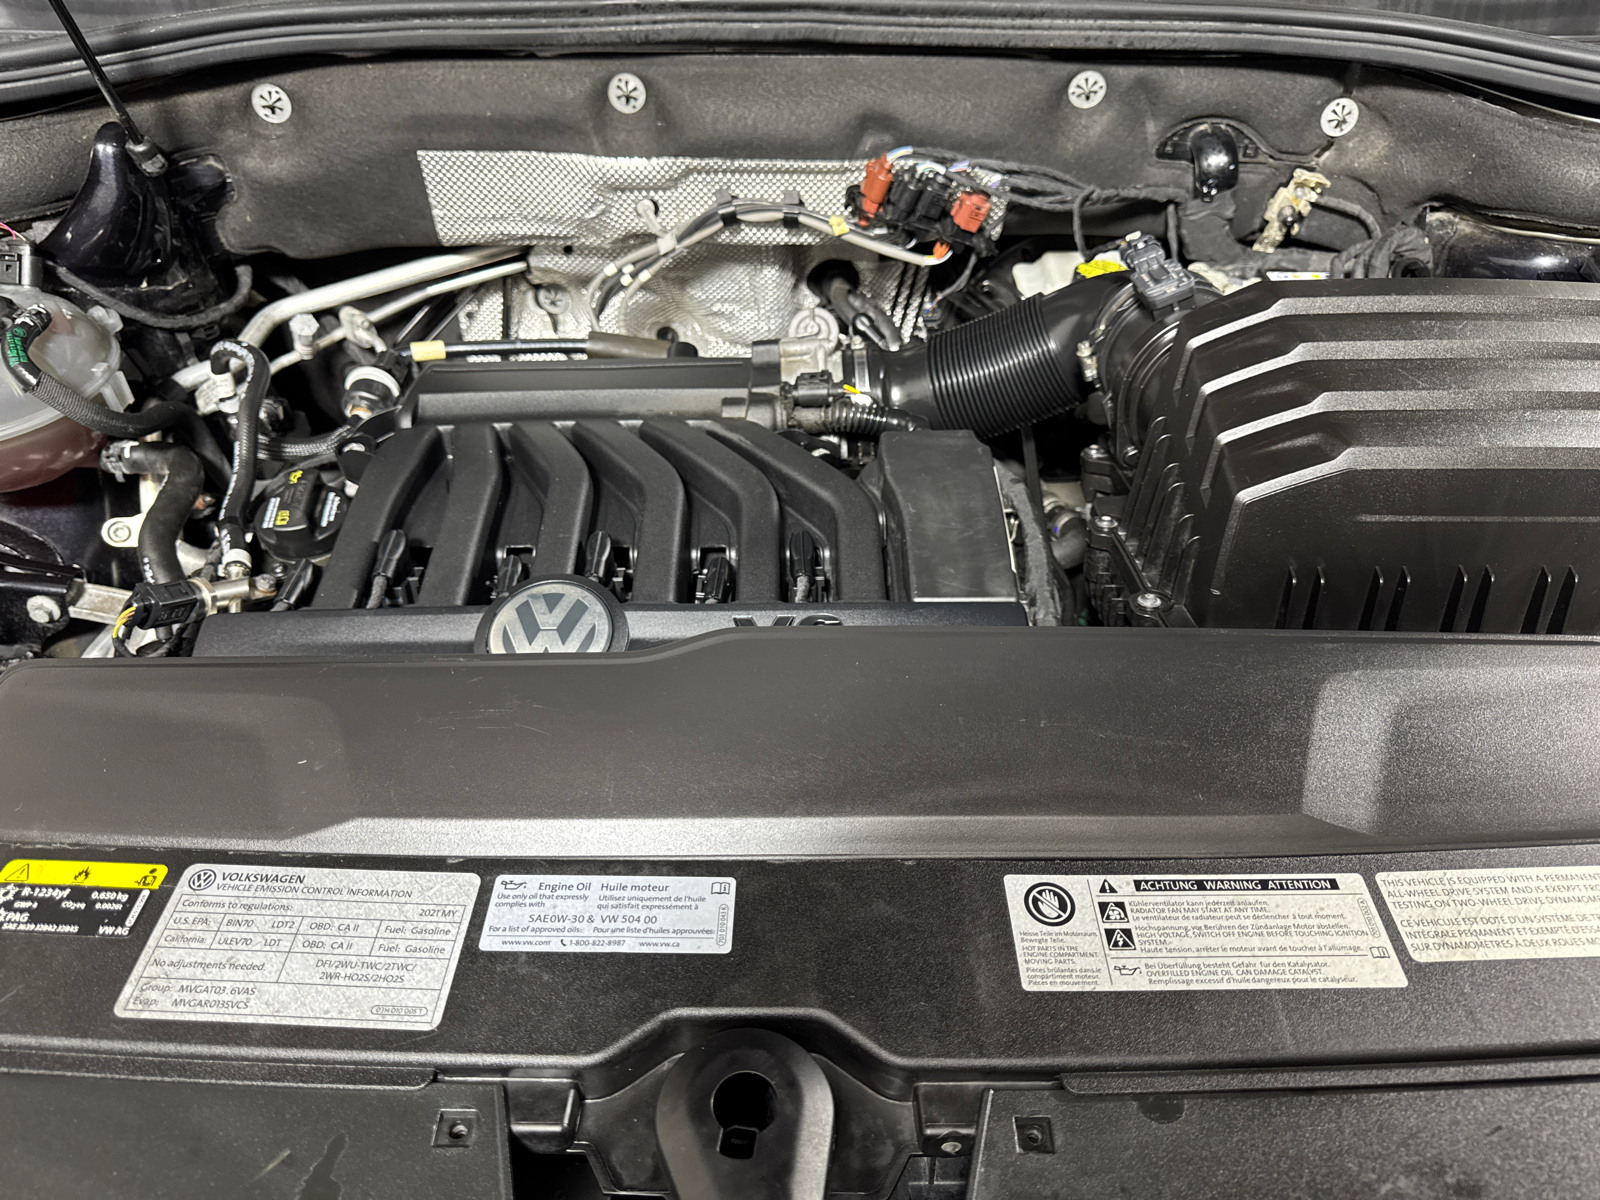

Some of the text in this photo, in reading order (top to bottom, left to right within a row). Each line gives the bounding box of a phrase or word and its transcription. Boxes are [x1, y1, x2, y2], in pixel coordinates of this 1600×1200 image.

[222, 872, 305, 884] VOLKSWAGEN
[1381, 879, 1404, 887] THIS
[1404, 878, 1445, 886] VEHICLE
[1446, 877, 1456, 885] IS
[1457, 875, 1506, 885] EQUIPPED
[1506, 875, 1534, 883] WITH
[216, 883, 413, 898] VEHICLE EMISSION CONTROL INFORMATION
[538, 882, 591, 893] Engine Oil
[600, 883, 670, 892] Huile moteur
[1140, 880, 1331, 890] ACHTUNG WARNING ATTENTION
[21, 886, 129, 902] R-1234yf 0.650 kg
[1387, 888, 1441, 898] ALL-WHEEL
[1441, 888, 1471, 897] DRIVE
[1472, 886, 1509, 895] SYSTEM
[1511, 885, 1533, 894] AND
[1535, 885, 1544, 893] IS
[1545, 884, 1582, 893] EXEMPT
[512, 893, 528, 901] only
[555, 893, 589, 902] expressly
[627, 895, 672, 903] uniquement
[1390, 900, 1432, 909] TESTING
[1434, 899, 1451, 908] ON
[1451, 897, 1514, 907] TWO-WHEEL
[1514, 896, 1545, 905] DRIVE
[182, 899, 226, 909] Conforms
[228, 901, 237, 909] to
[239, 901, 293, 911] regulations:
[419, 908, 440, 917] 2021
[494, 901, 527, 909] complies
[641, 903, 692, 911] expressément
[6, 911, 30, 922] PAG
[528, 914, 658, 924] SAE0W-30 & VW 504 00
[1400, 919, 1411, 928] CE
[1462, 917, 1479, 926] EST
[1576, 914, 1587, 922] DE
[98, 925, 130, 935] VW AG
[173, 917, 190, 925] U.S.
[192, 917, 211, 926] EPA:
[225, 919, 254, 927] BIN70
[271, 920, 295, 929] LDT2
[309, 922, 333, 931] OBD:
[337, 923, 350, 931] CA
[384, 926, 407, 934] Fuel:
[411, 926, 451, 936] Gasoline
[530, 926, 566, 934] approved
[626, 926, 642, 934] liste
[1157, 931, 1192, 939] VOLTAGE,
[1458, 927, 1515, 938] PERMANENT
[1516, 927, 1526, 936] ET
[164, 935, 207, 944] California:
[217, 937, 253, 946] ULEV70
[263, 938, 283, 947] LDT
[302, 940, 326, 949] OBD:
[330, 941, 343, 950] CA
[378, 943, 401, 952] Fuel:
[404, 944, 445, 954] Gasoline
[569, 939, 626, 947] 1-800-822-8987
[1410, 942, 1432, 951] SUR
[1522, 938, 1551, 947] DEUX
[1552, 937, 1585, 946] ROUES
[151, 959, 266, 971] No adjustments needed.
[140, 982, 172, 993] Group:
[133, 996, 159, 1006] Evap:
